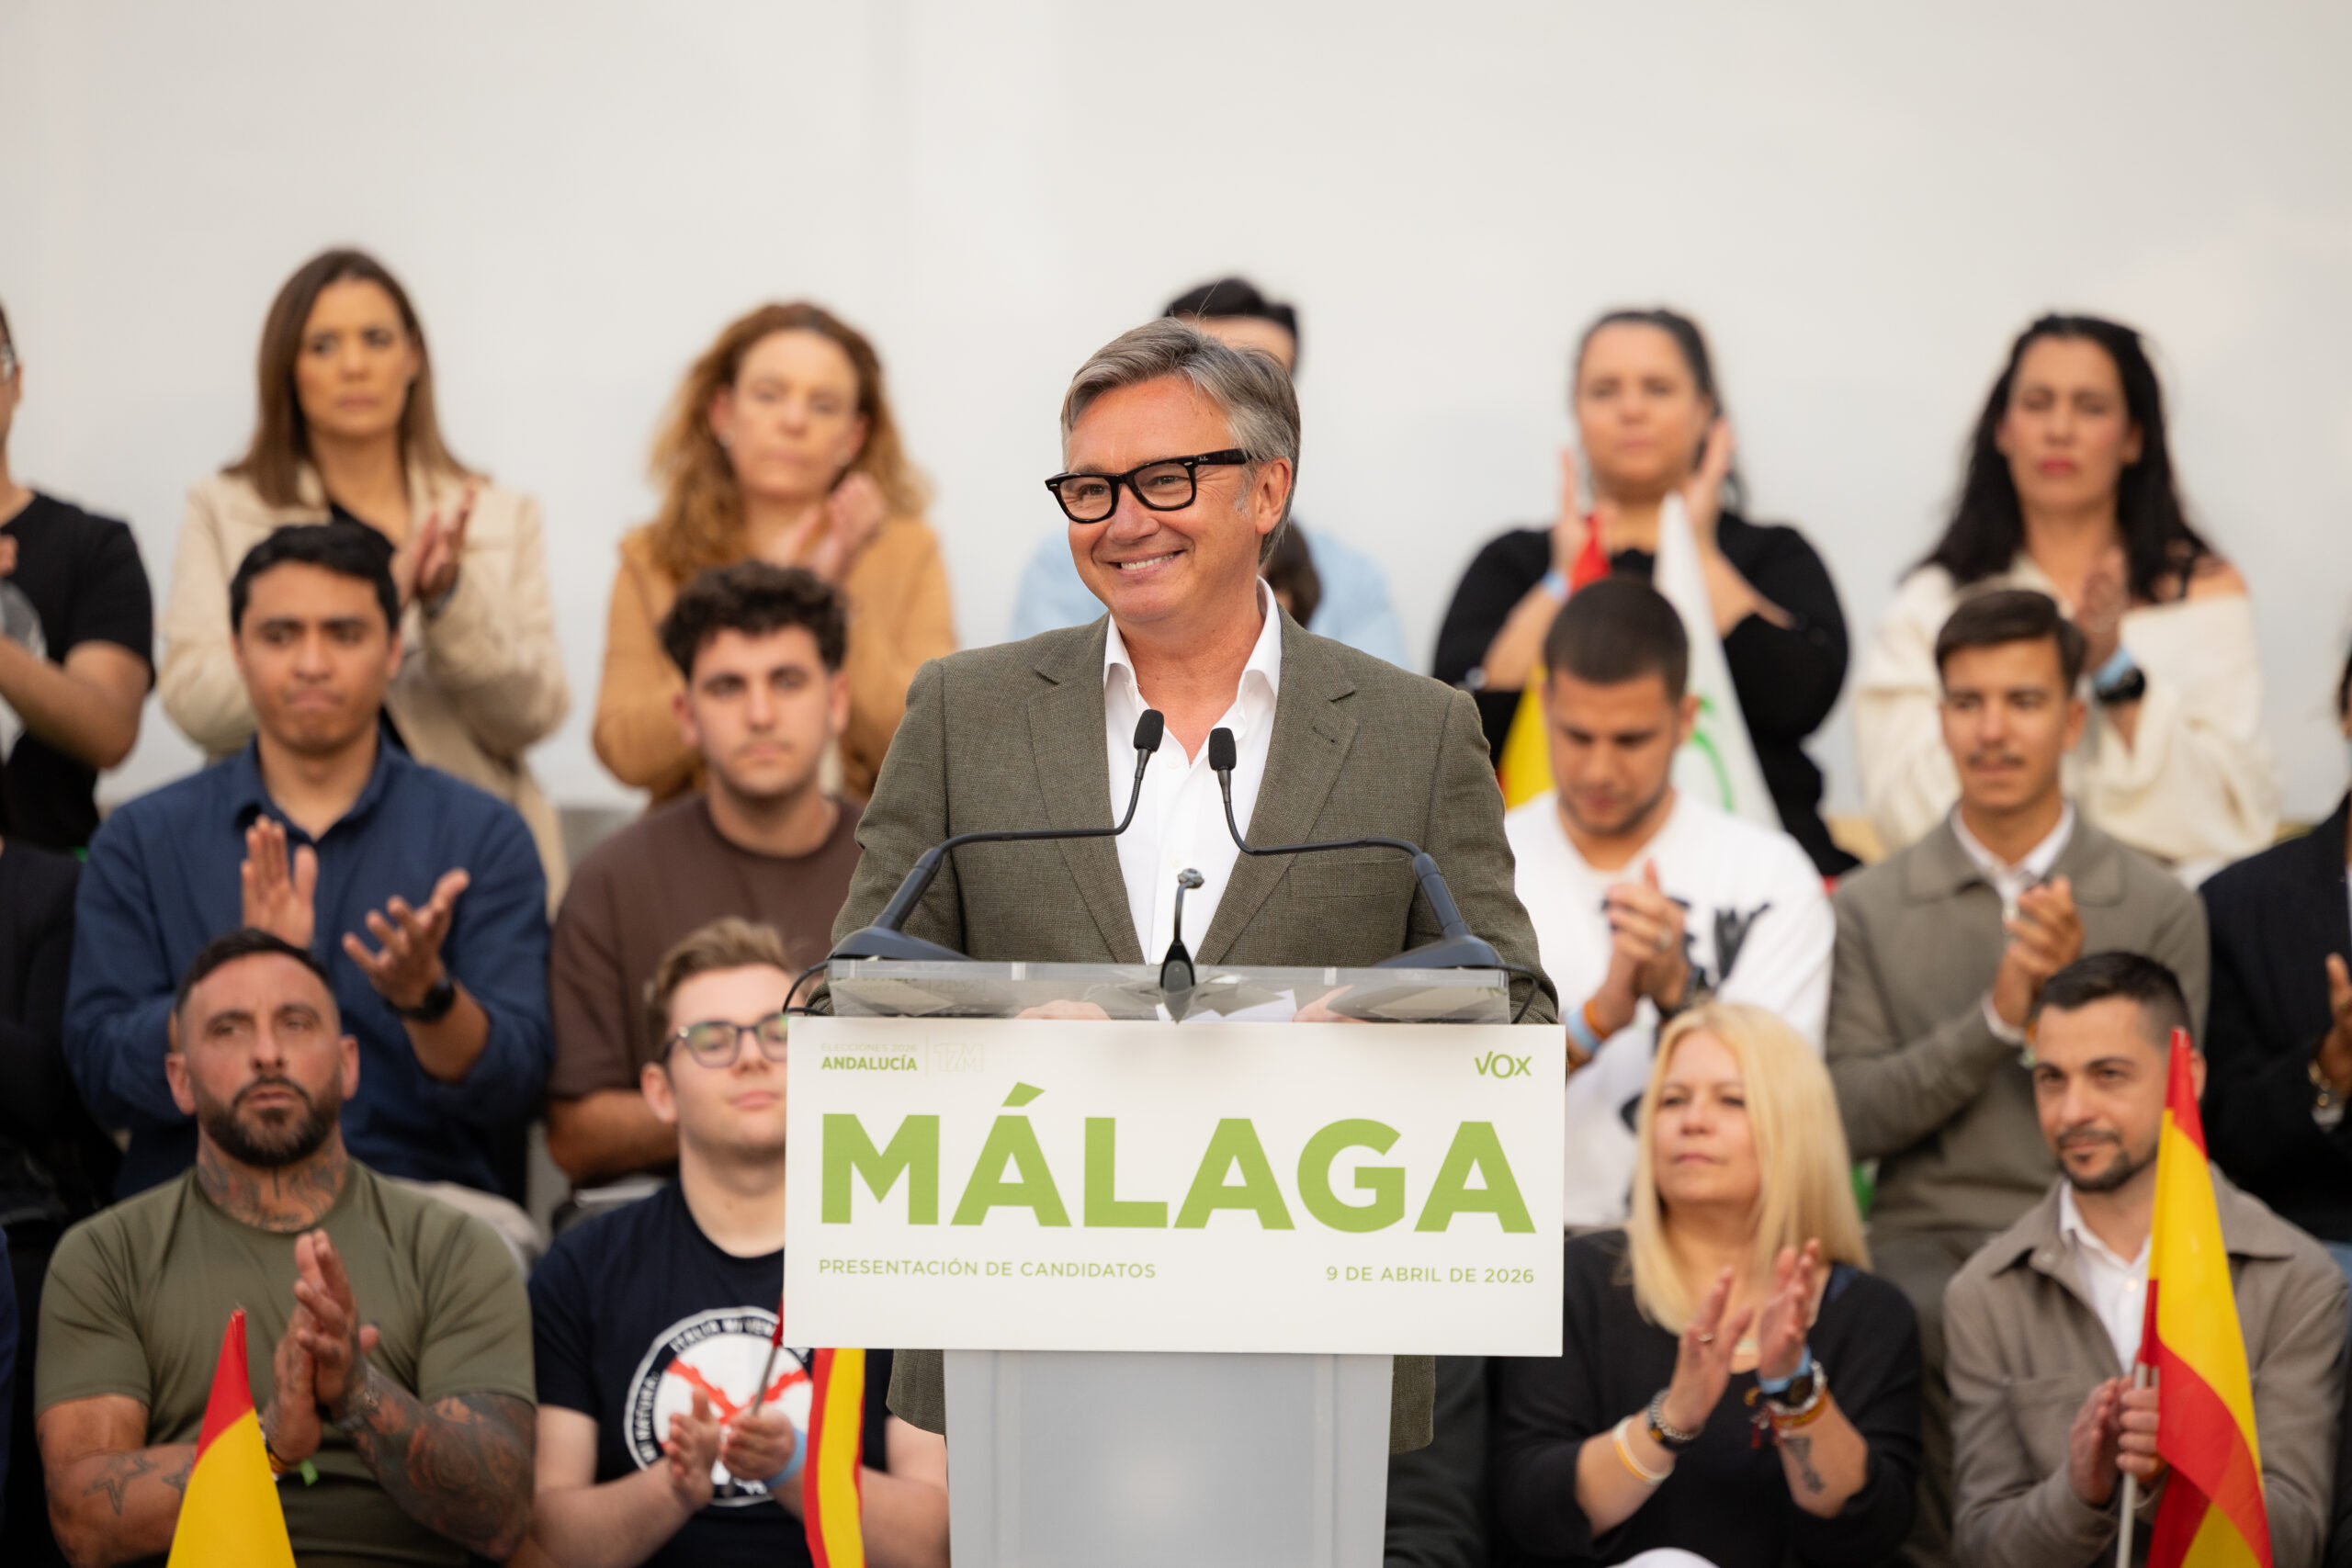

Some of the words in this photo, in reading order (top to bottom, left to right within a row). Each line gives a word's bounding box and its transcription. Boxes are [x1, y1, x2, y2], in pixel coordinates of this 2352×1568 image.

[820, 1043, 888, 1053] ELECCIONES
[891, 1043, 918, 1053] 2026
[820, 1054, 918, 1071] ANDALUCÍA
[1475, 1051, 1532, 1079] VOX
[820, 1081, 1537, 1235] MÁLAGA
[819, 1256, 978, 1276] PRESENTACIÓN
[986, 1261, 1012, 1277] DE
[1020, 1262, 1155, 1279] CANDIDATOS
[1326, 1266, 1338, 1281] 9
[1345, 1267, 1373, 1281] DE
[1380, 1267, 1442, 1282] ABRIL
[1449, 1268, 1477, 1283] DE
[1484, 1269, 1535, 1284] 2026
